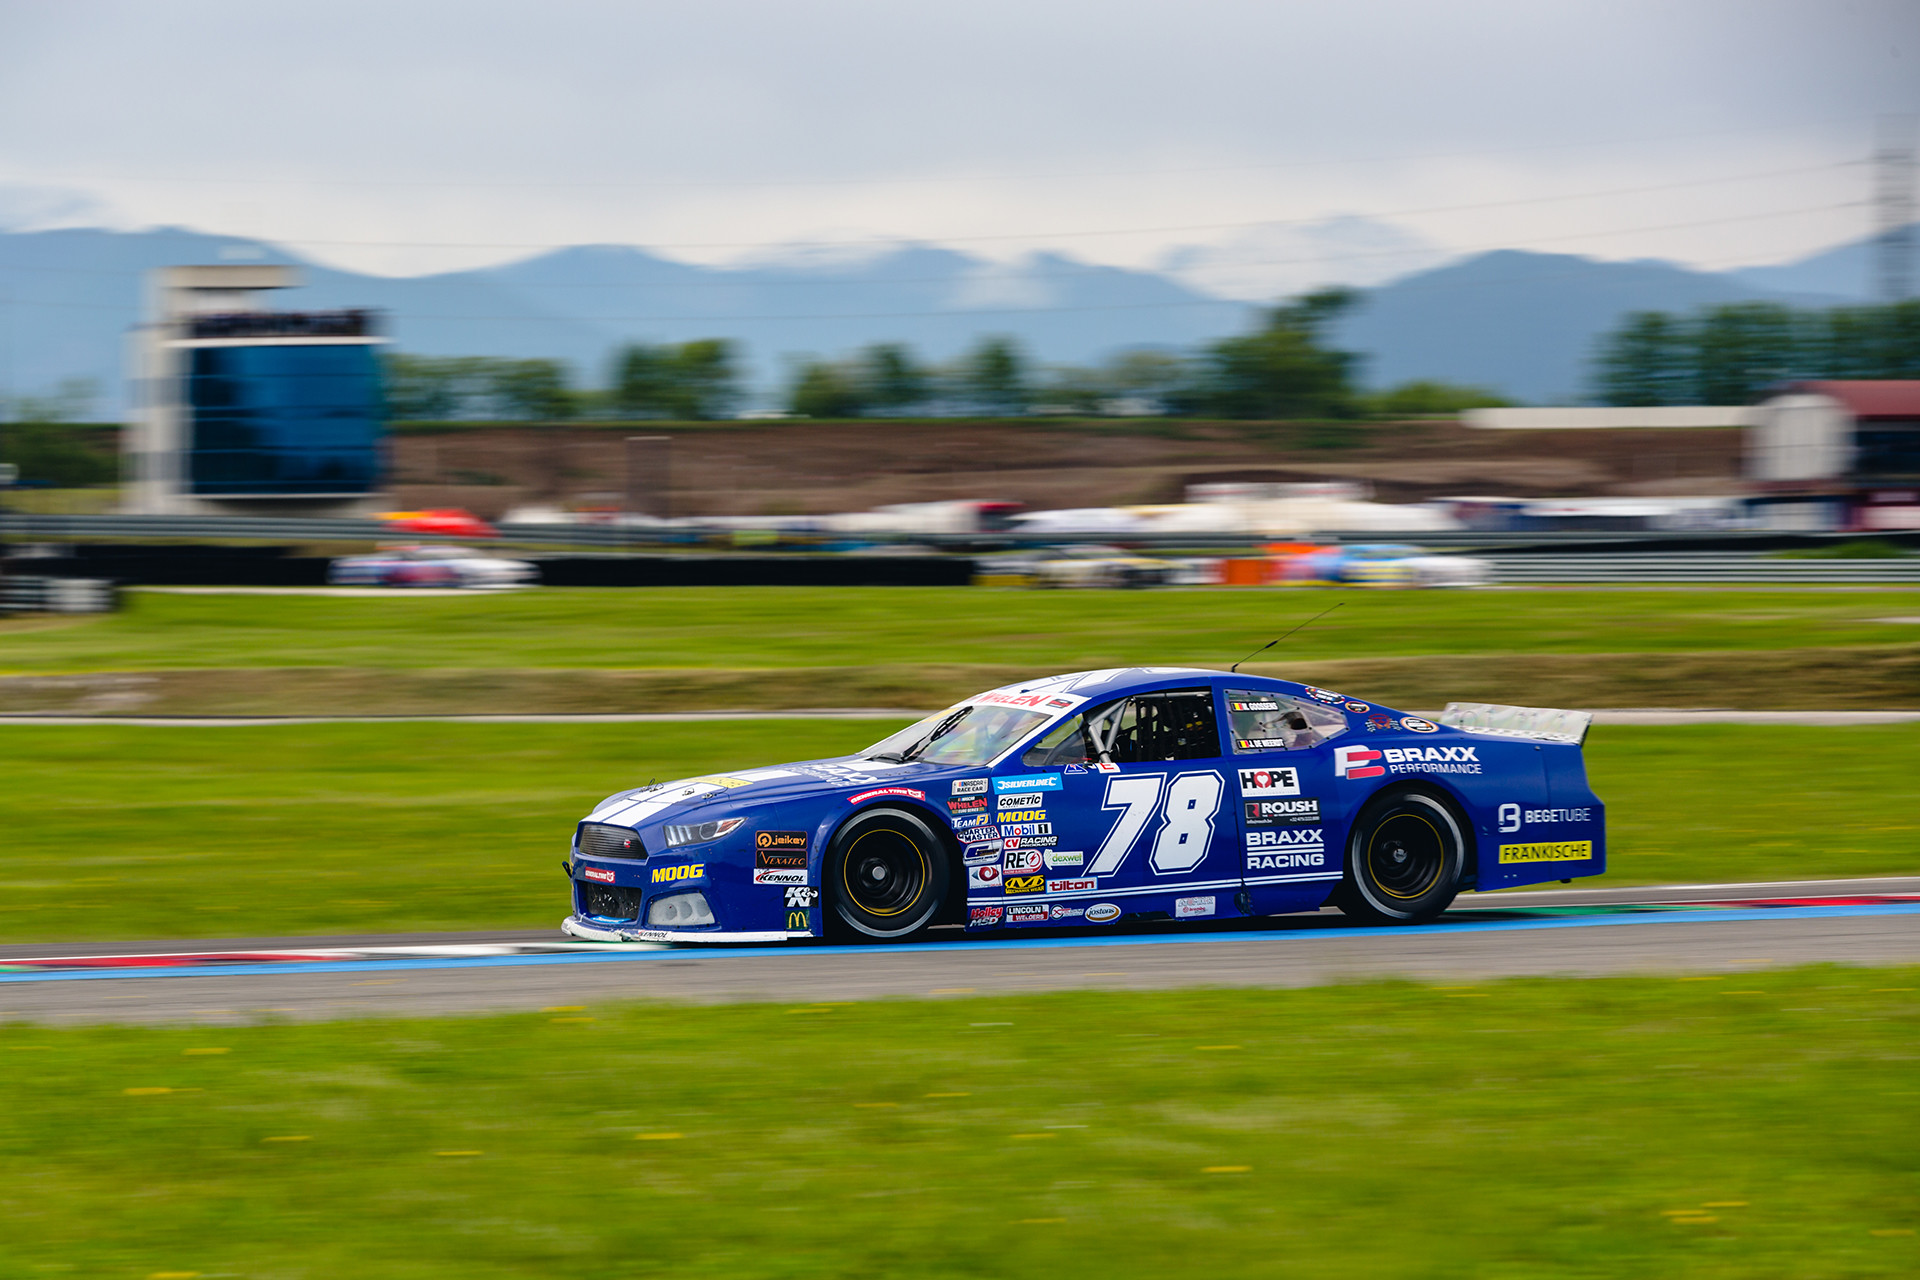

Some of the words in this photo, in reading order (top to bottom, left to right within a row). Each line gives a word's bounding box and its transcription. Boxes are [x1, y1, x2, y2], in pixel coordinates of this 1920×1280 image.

[1383, 746, 1479, 763] BRAXX
[1389, 763, 1482, 774] PERFORMANCE
[1004, 778, 1050, 789] SILVERLINE
[1240, 770, 1295, 789] HOPE
[850, 789, 888, 804] GENERAL
[947, 797, 988, 810] WHELEN
[1261, 800, 1318, 814] ROUSH
[996, 809, 1047, 823] MOOG
[1524, 807, 1592, 823] BEGETUBE
[1003, 824, 1036, 837] Mobil
[1038, 823, 1048, 834] 1
[1082, 770, 1225, 877] 78
[964, 832, 998, 842] MASTER
[1005, 838, 1020, 848] CV
[1020, 836, 1058, 845] RACING
[1245, 828, 1324, 846] BRAXX
[760, 850, 806, 866] VEXATEC
[1051, 853, 1083, 863] dexwet
[1246, 853, 1325, 870] RACING
[651, 863, 705, 884] MOOG
[758, 874, 804, 882] KENNOL
[1049, 880, 1095, 892] tilton
[970, 906, 1004, 919] Holley
[1008, 906, 1042, 915] LINCOLN
[1088, 907, 1115, 919] jostens
